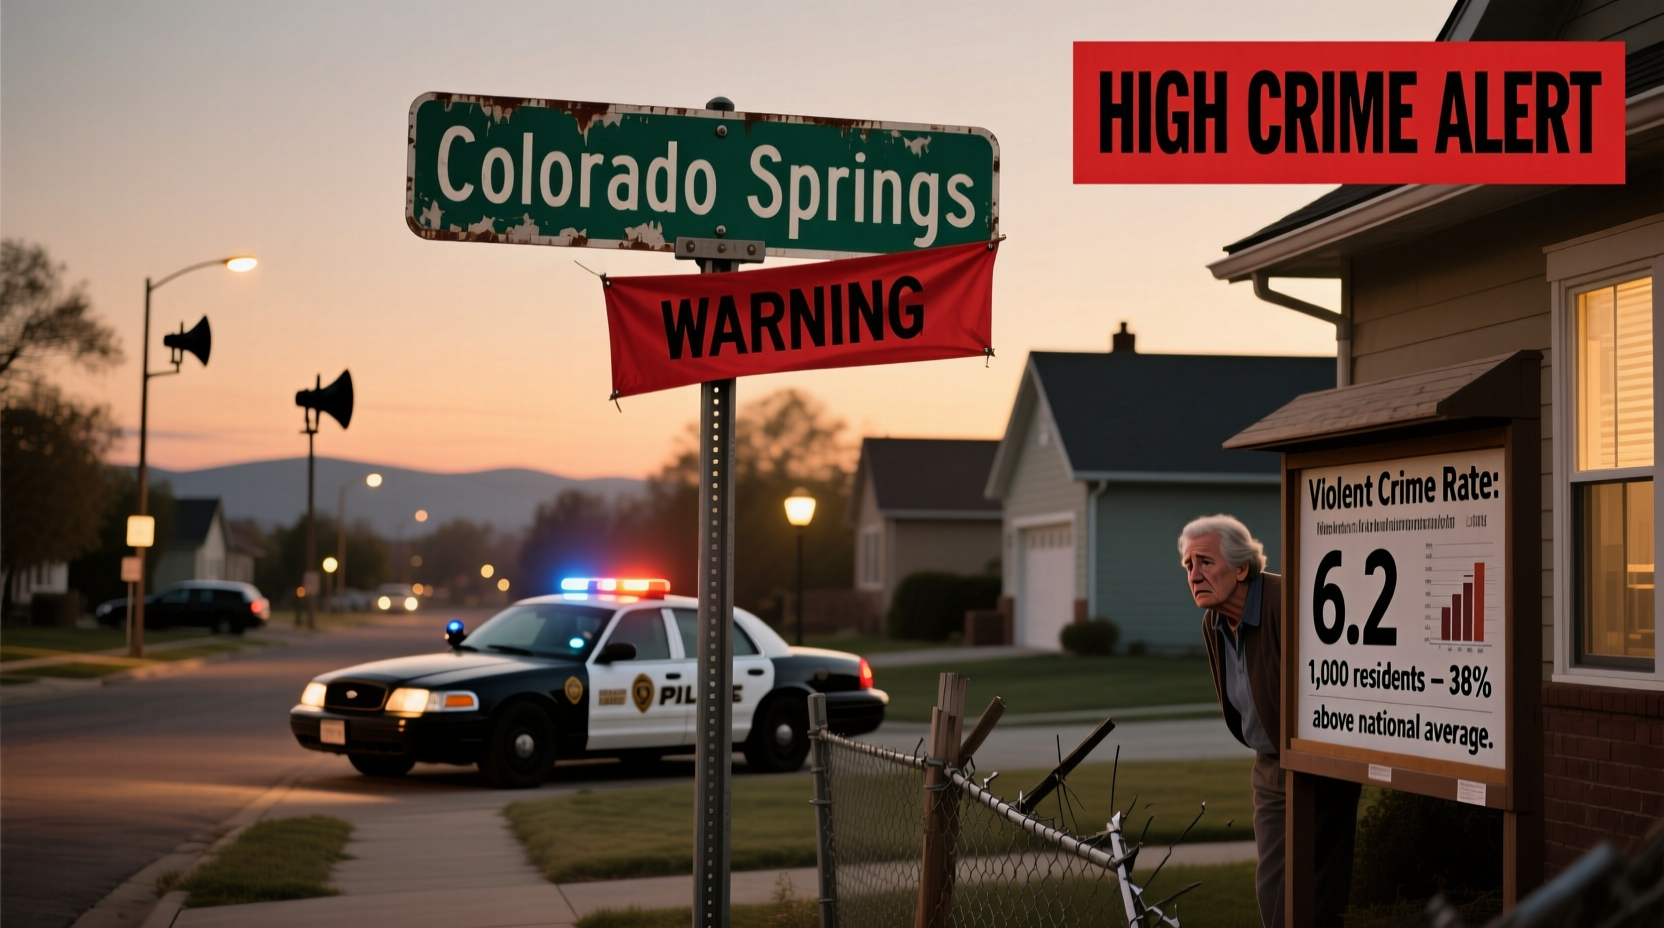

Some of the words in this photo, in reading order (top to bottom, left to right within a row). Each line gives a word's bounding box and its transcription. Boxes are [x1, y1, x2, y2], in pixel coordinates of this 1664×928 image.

[436, 125, 718, 216] Colorado
[746, 144, 977, 248] Springs
[660, 275, 925, 361] WARNING
[1308, 475, 1373, 511] Violent
[1377, 469, 1436, 506] Crime
[1442, 465, 1500, 503] Rate:
[1312, 548, 1398, 647] 6.2
[1308, 659, 1349, 691] 1,000
[1353, 661, 1426, 692] residents
[1448, 664, 1492, 699] 38%
[1312, 704, 1355, 733] above
[1358, 709, 1421, 740] national
[1423, 721, 1494, 756] average.
